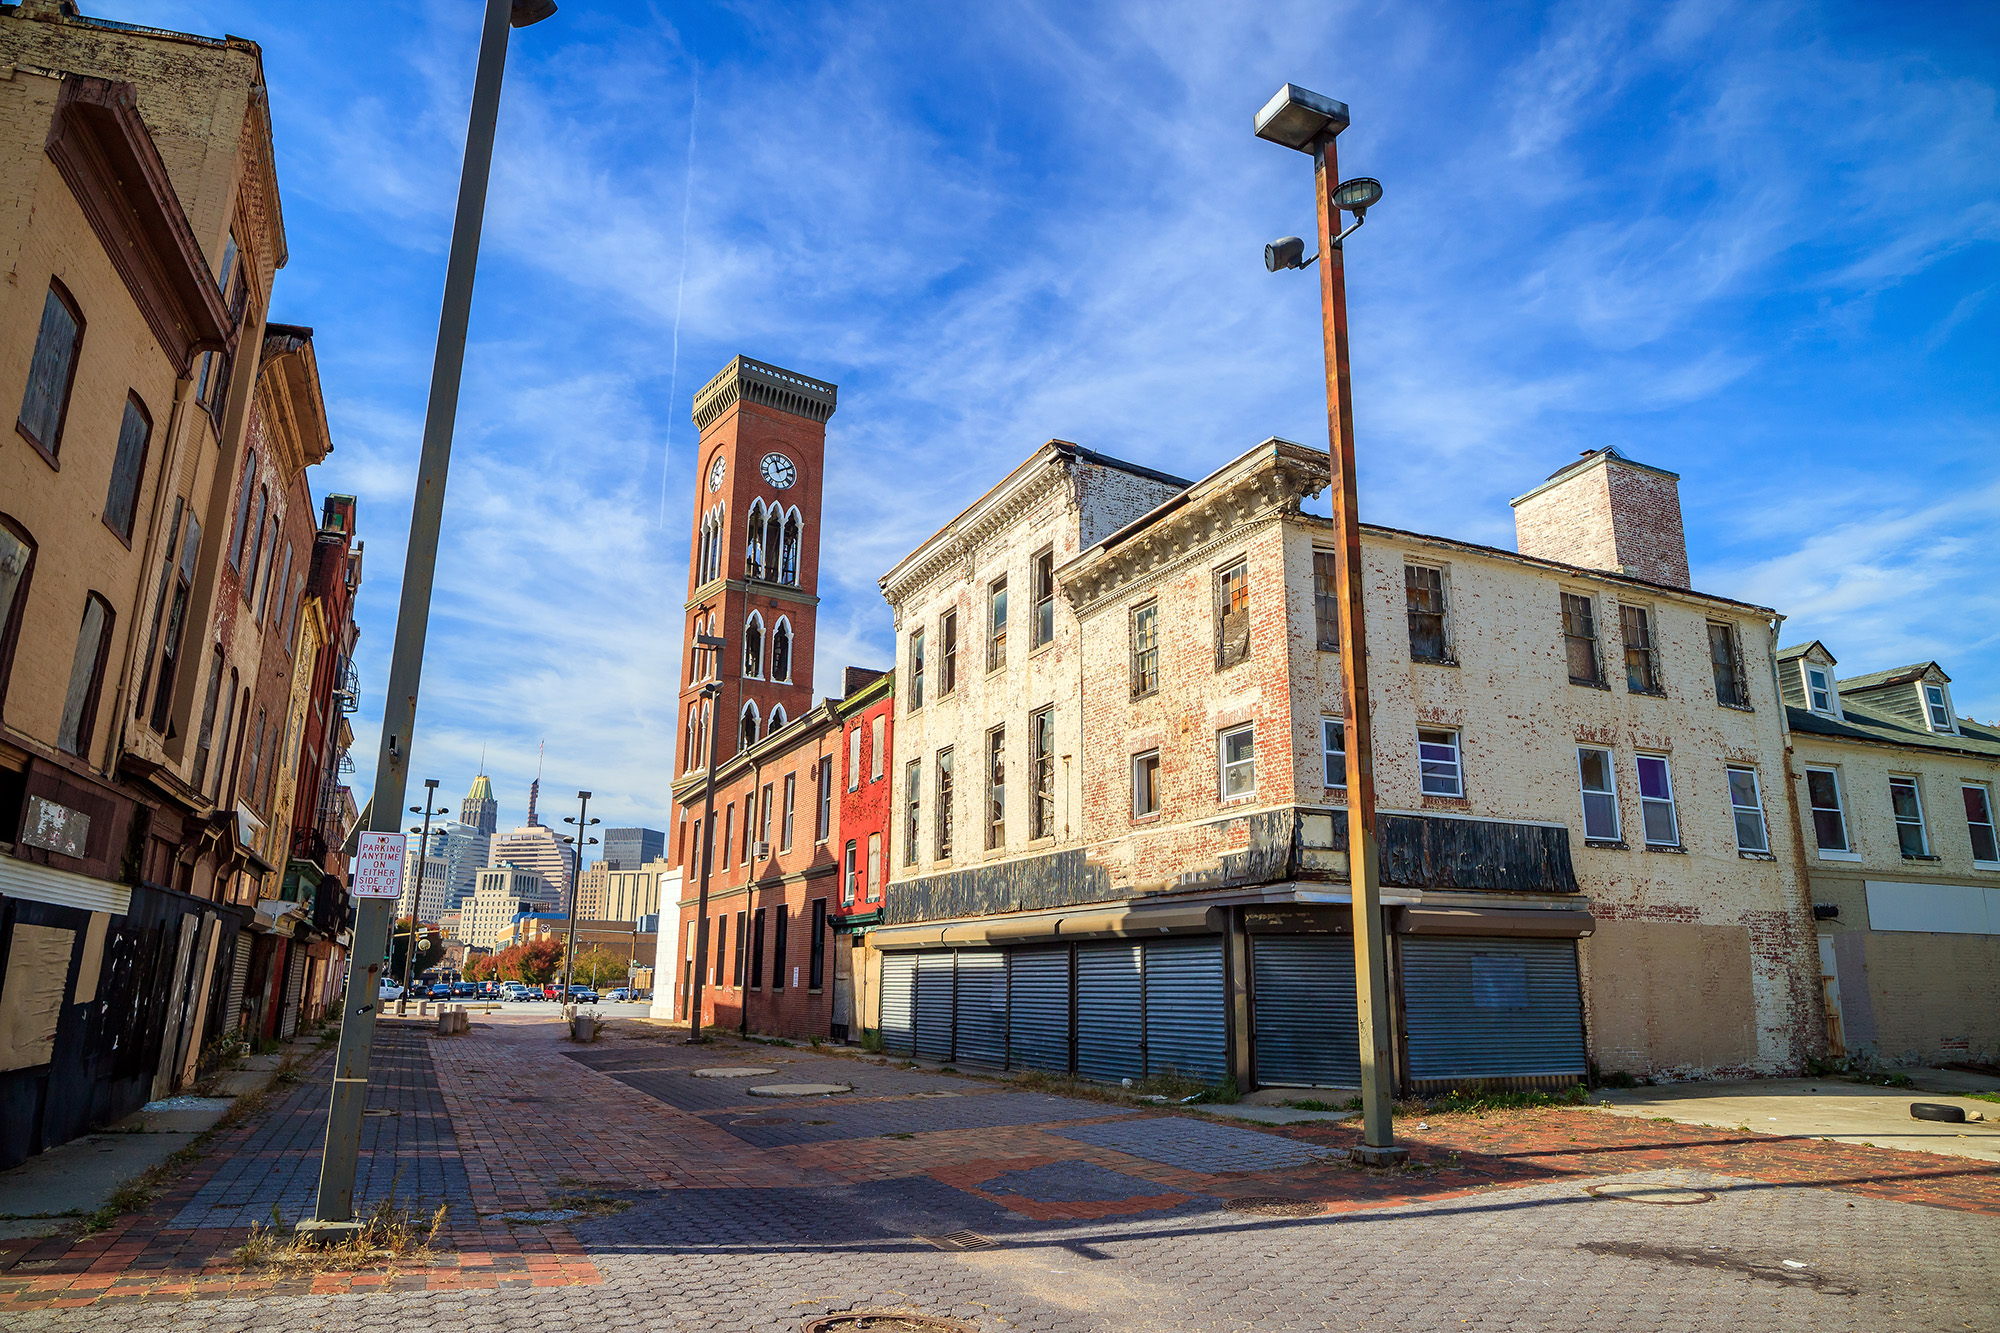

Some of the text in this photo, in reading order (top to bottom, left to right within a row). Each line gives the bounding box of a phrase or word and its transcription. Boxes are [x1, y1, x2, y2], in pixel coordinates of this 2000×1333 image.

[362, 844, 401, 852] PARKING
[362, 852, 399, 861] ANYTIME
[360, 885, 394, 893] STREET
